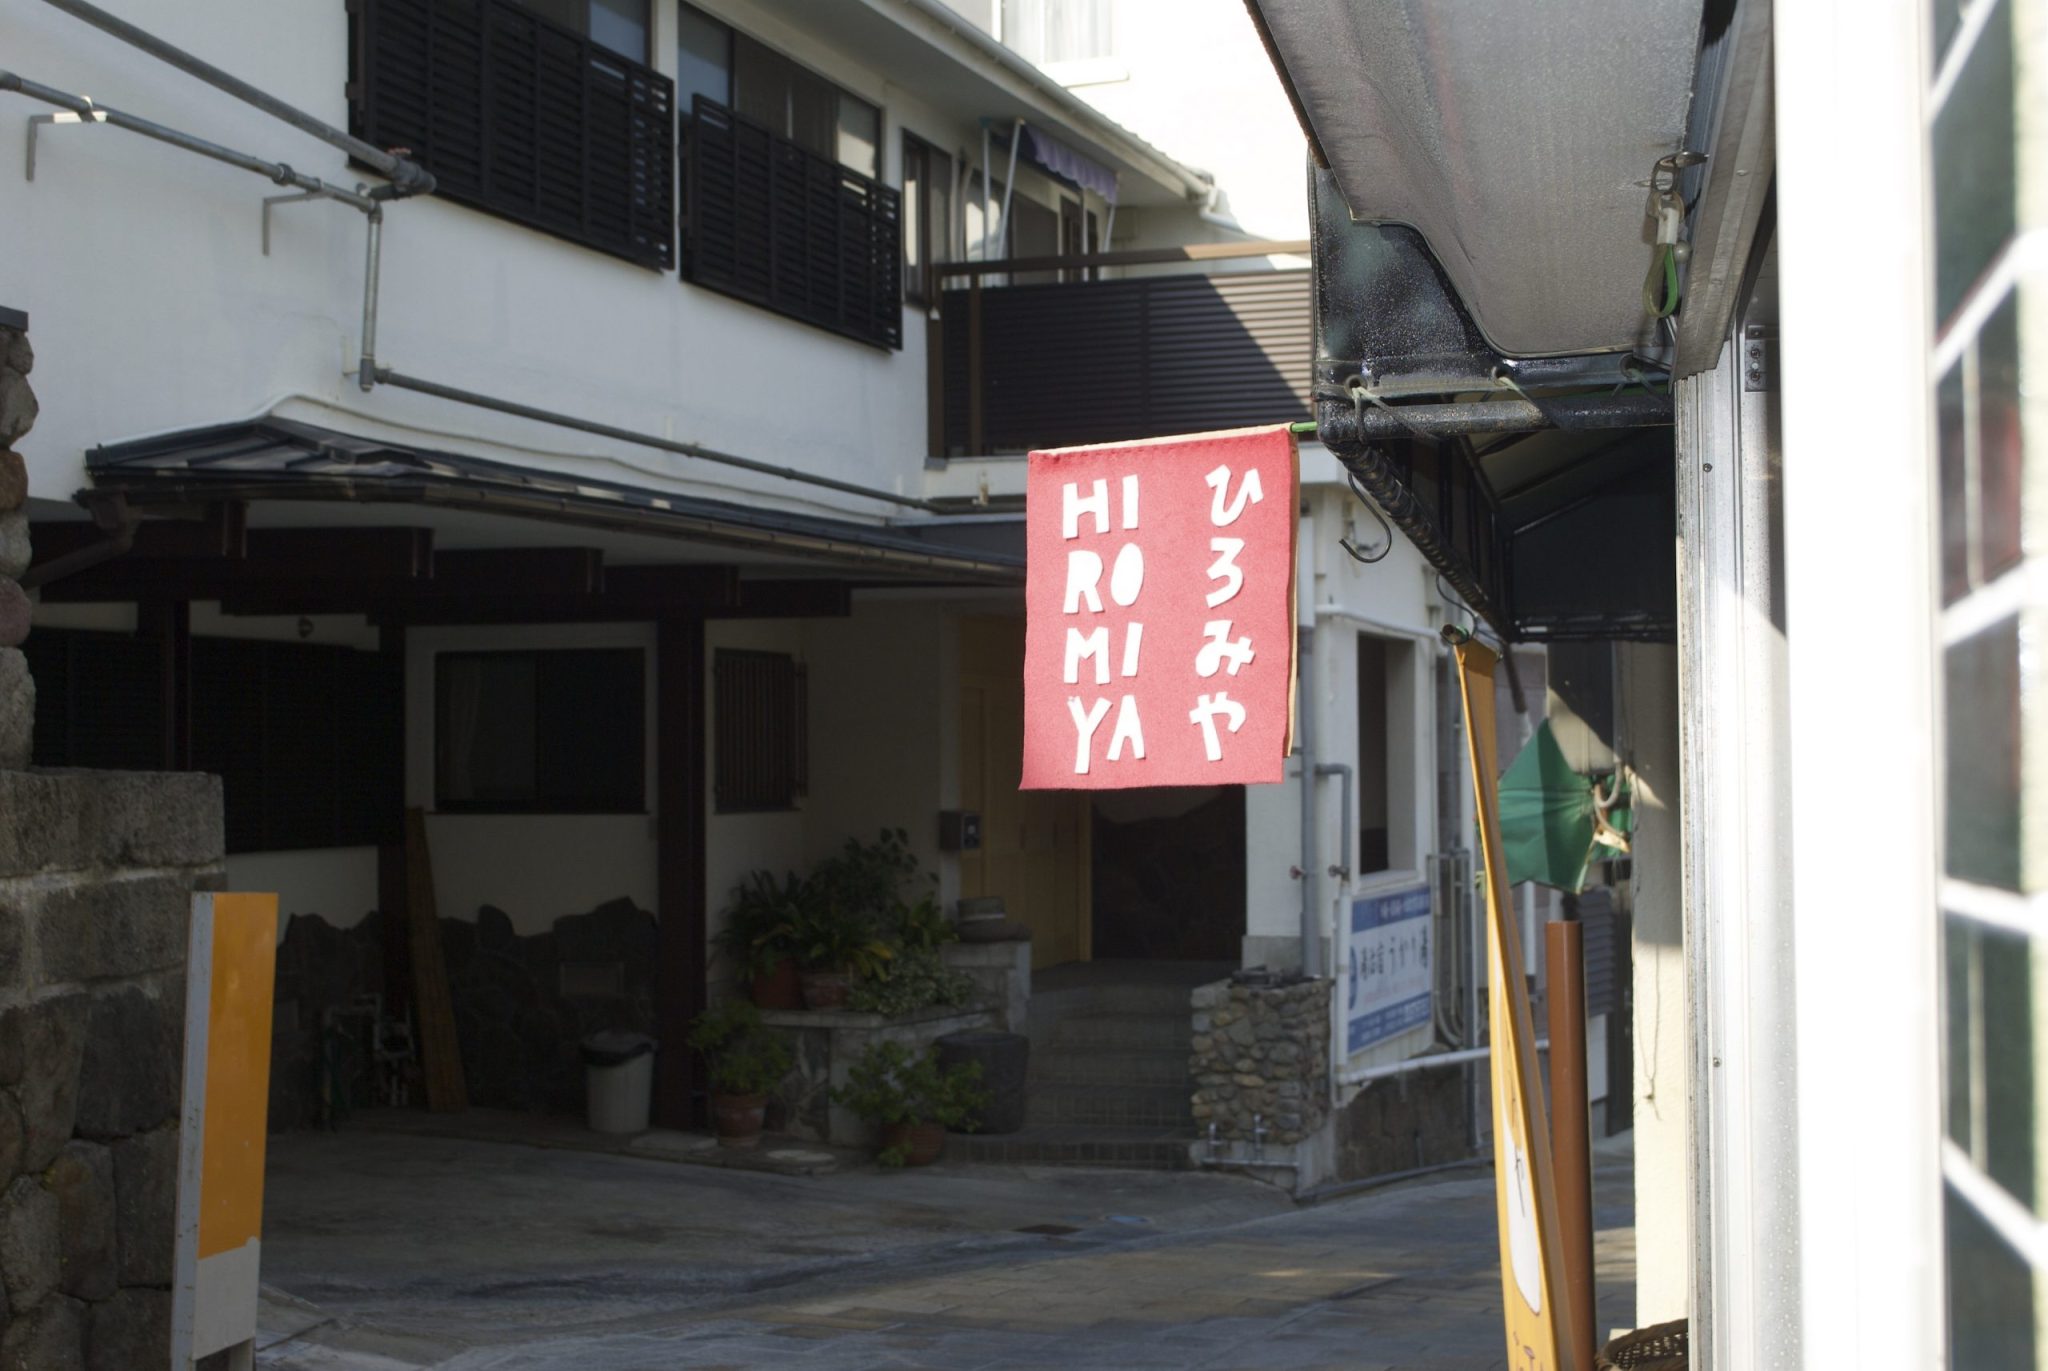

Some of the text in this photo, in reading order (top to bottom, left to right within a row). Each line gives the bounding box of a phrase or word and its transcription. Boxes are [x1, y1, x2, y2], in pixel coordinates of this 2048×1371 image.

[1062, 474, 1139, 539] HI
[1063, 543, 1145, 614] RO
[1189, 464, 1263, 761] ひろみや
[1064, 622, 1143, 684] MI
[1067, 694, 1145, 774] YA
